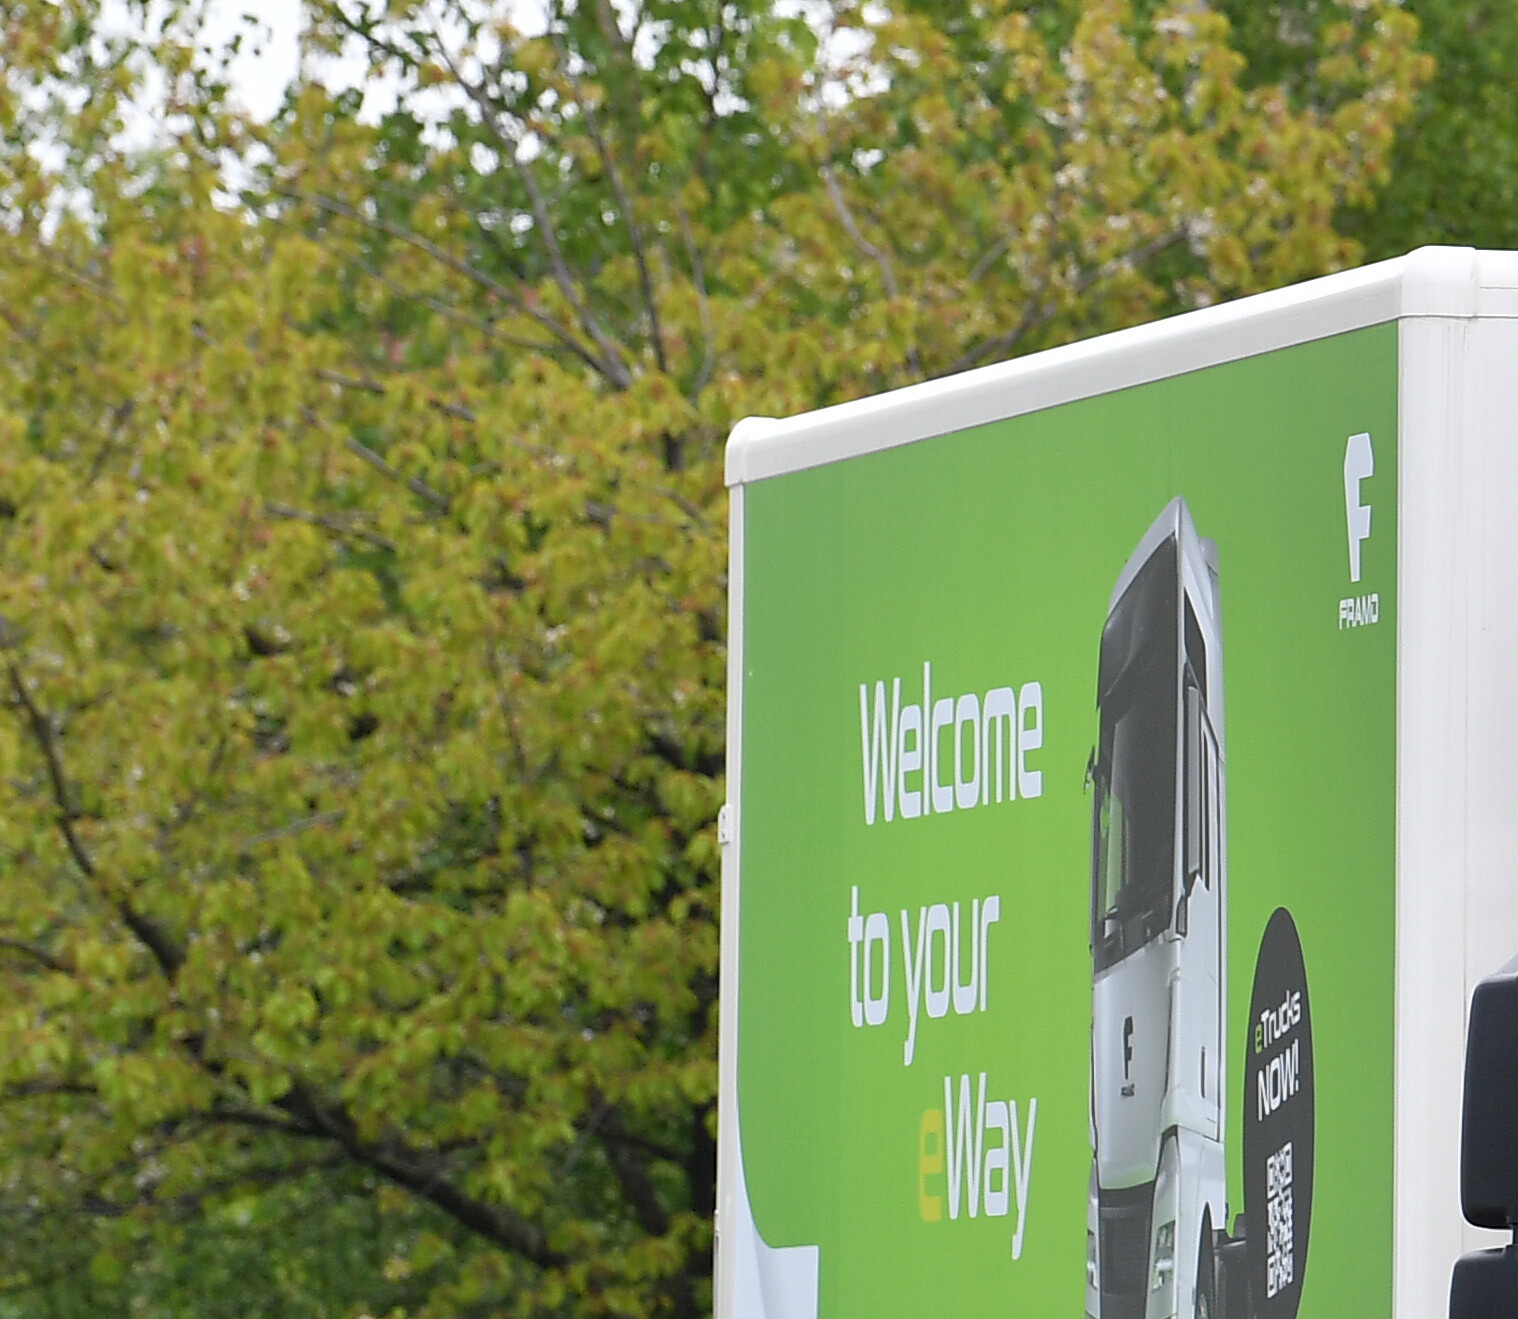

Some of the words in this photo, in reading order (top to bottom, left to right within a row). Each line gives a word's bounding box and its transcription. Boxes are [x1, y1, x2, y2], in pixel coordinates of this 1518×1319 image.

[1339, 593, 1379, 630] FRAMO
[859, 661, 1042, 825] Welcome
[848, 885, 890, 1028] to
[900, 895, 1000, 1066] your
[1255, 989, 1301, 1054] eTrucks
[1257, 1038, 1299, 1122] NOW!
[919, 1072, 1037, 1260] eWay
